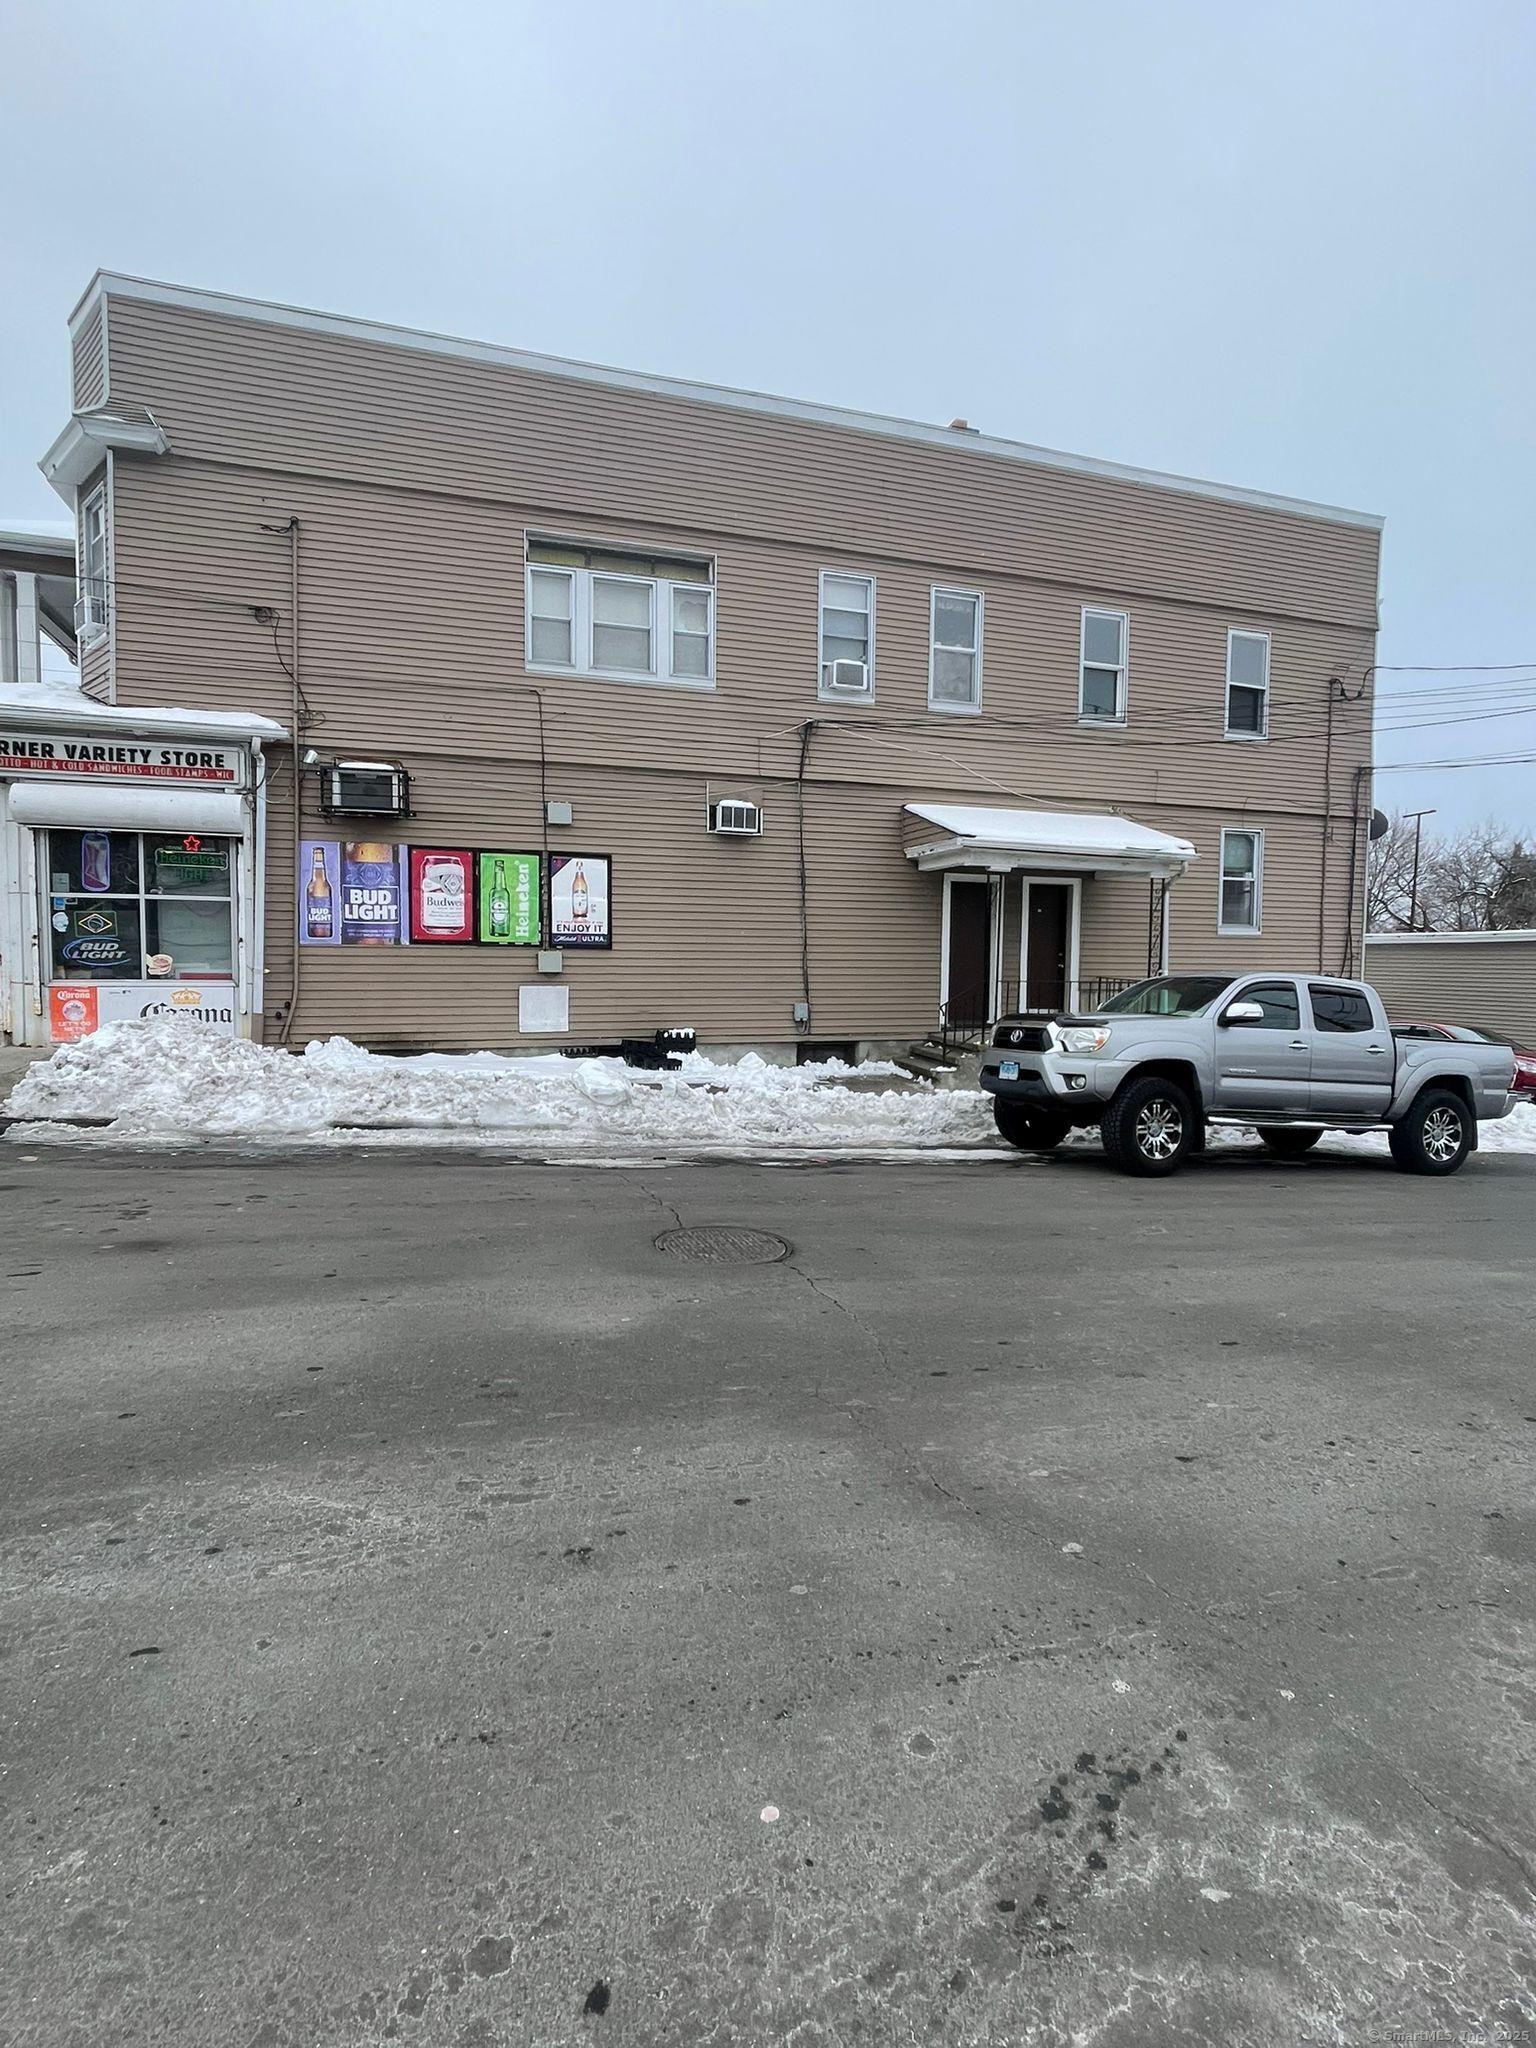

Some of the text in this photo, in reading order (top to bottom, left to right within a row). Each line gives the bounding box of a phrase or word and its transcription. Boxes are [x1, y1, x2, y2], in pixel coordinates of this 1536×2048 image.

[64, 744, 152, 763] VARIETY
[160, 750, 225, 768] STORE
[30, 759, 48, 769] HOT
[51, 761, 59, 770] &
[62, 761, 85, 771] COLD
[87, 762, 142, 775] SANDWICHES
[150, 766, 172, 776] FOOD
[176, 768, 208, 778] STAMPS
[349, 889, 392, 905] BUD
[515, 863, 530, 937] Heineken
[344, 904, 398, 920] LIGHT
[556, 924, 604, 933] ENJOY IT
[80, 942, 119, 951] BUD
[71, 951, 126, 959] LIGHT
[57, 990, 90, 1001] Corona
